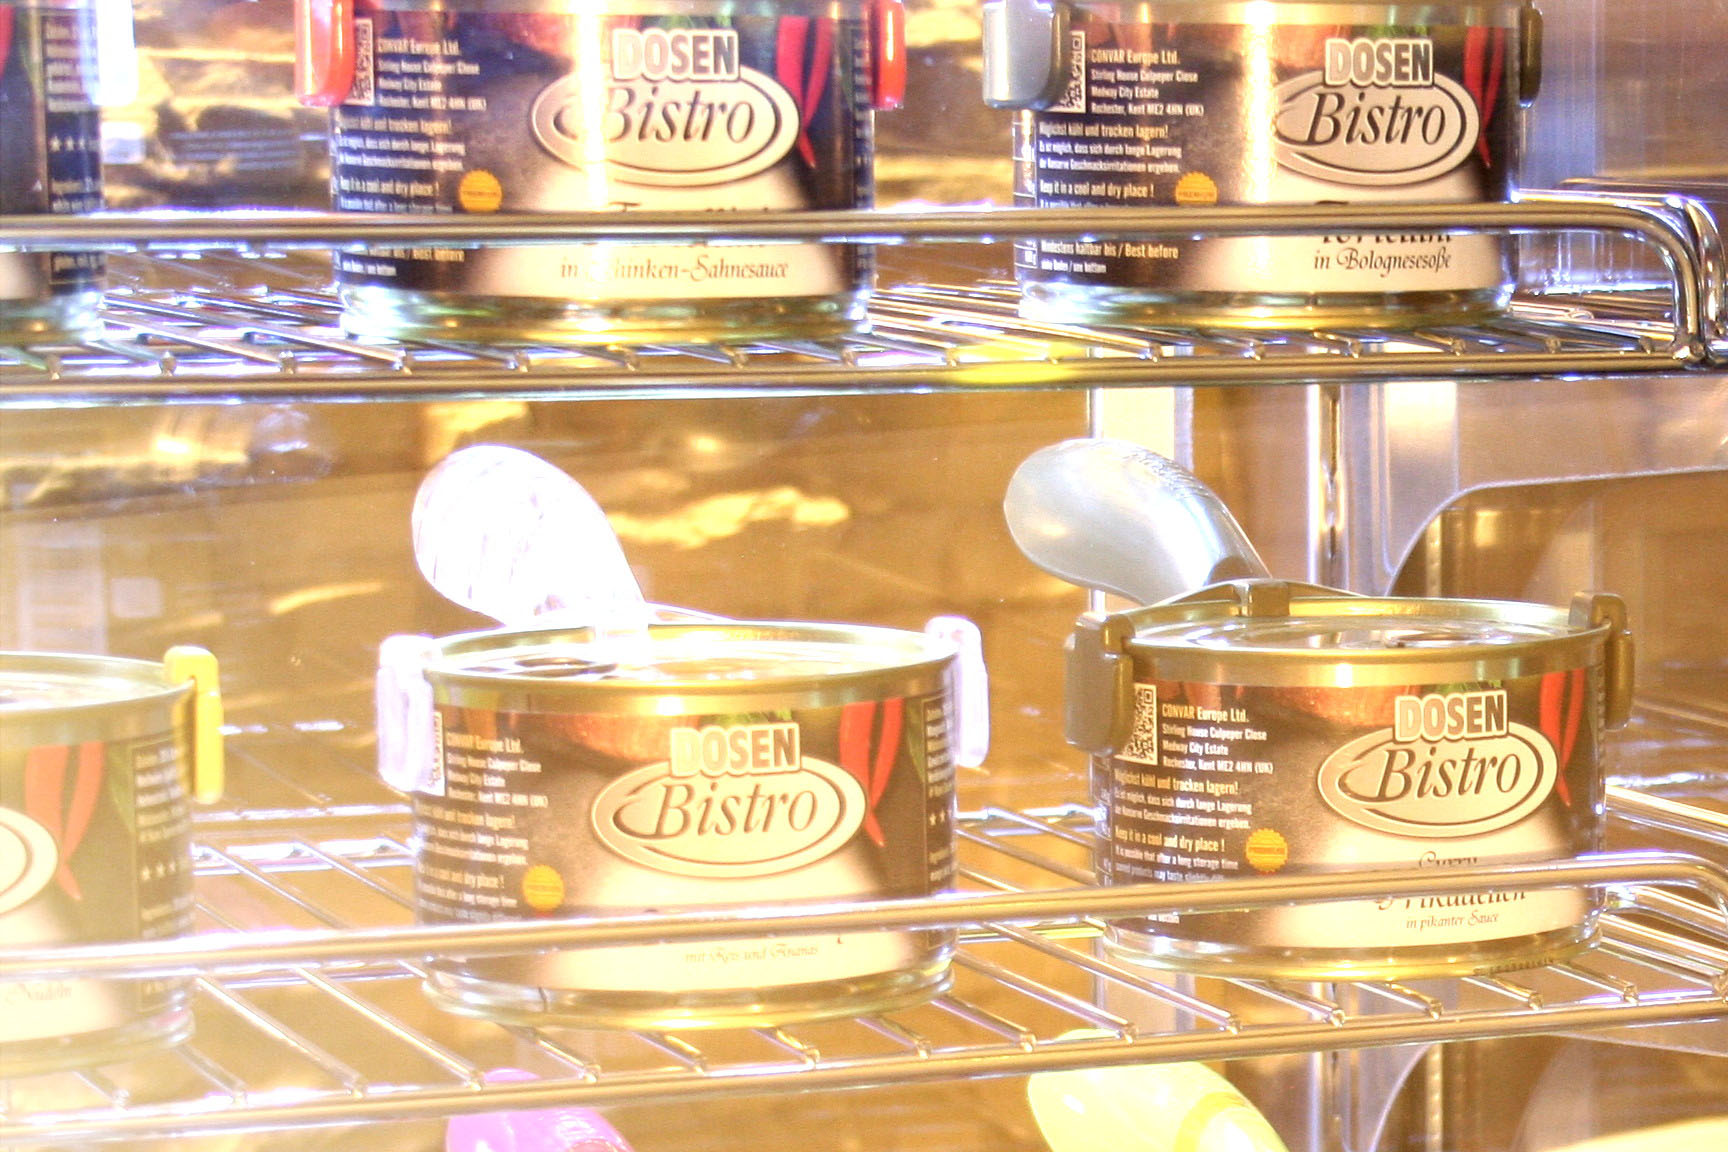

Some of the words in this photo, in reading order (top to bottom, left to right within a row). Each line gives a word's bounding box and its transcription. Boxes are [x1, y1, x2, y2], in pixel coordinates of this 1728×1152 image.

[613, 30, 738, 79] DOSEN
[1091, 49, 1125, 64] CONVAR
[1127, 49, 1159, 66] Europe
[1161, 50, 1181, 65] Ltd.
[1325, 38, 1434, 86] DOSEN
[1118, 86, 1132, 100] City
[1134, 86, 1159, 99] Estate
[554, 86, 755, 143] Bistro
[1275, 91, 1446, 146] Bistro
[1101, 125, 1134, 139] trocken
[1107, 182, 1121, 199] dry
[1123, 183, 1148, 199] place
[1124, 243, 1145, 258] Best
[1148, 243, 1179, 259] before
[1314, 250, 1330, 271] in
[1336, 247, 1452, 277] Bolognesesoße
[561, 258, 578, 279] in
[590, 253, 788, 281] hinken-Sahnesauce
[1162, 704, 1195, 719] CONVAR
[1197, 706, 1228, 723] Europe
[1230, 708, 1249, 723] Ltd.
[1396, 691, 1506, 740] DOSEN
[1245, 729, 1268, 741] Close
[670, 723, 799, 776] DOSEN
[1189, 742, 1203, 756] City
[1205, 743, 1229, 756] Estate
[1338, 747, 1521, 802] Bistro
[1207, 779, 1239, 797] lagern!
[612, 782, 819, 840] Bistro
[1179, 835, 1193, 852] dry
[1195, 837, 1219, 852] place
[1419, 915, 1464, 931] pikanter
[1468, 909, 1499, 927] Sauce
